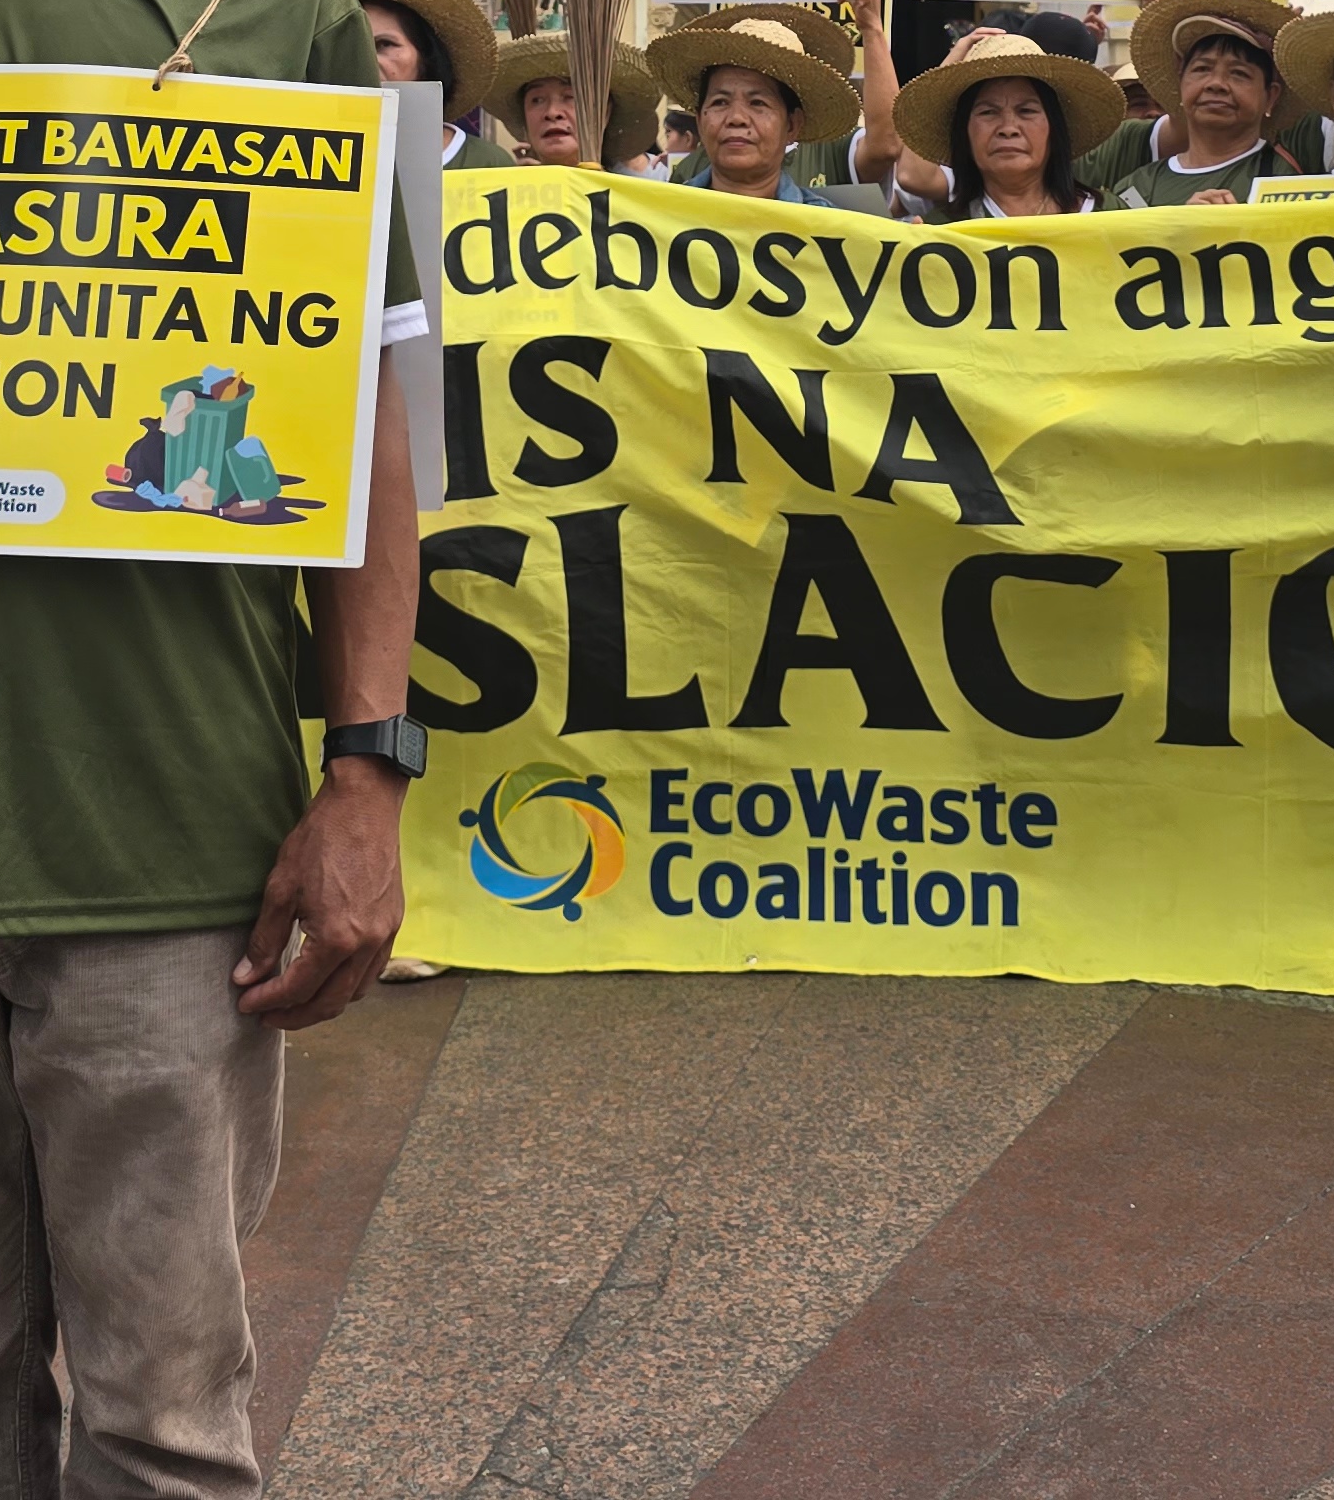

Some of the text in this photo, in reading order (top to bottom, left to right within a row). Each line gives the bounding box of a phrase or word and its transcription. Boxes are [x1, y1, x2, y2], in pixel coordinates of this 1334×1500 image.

[43, 119, 355, 183] BAWASAN
[443, 188, 1068, 346] debosyon
[230, 289, 341, 349] NG
[697, 345, 1026, 526] NA
[649, 767, 1059, 848] EcoWaste
[649, 841, 1019, 928] Coalition
